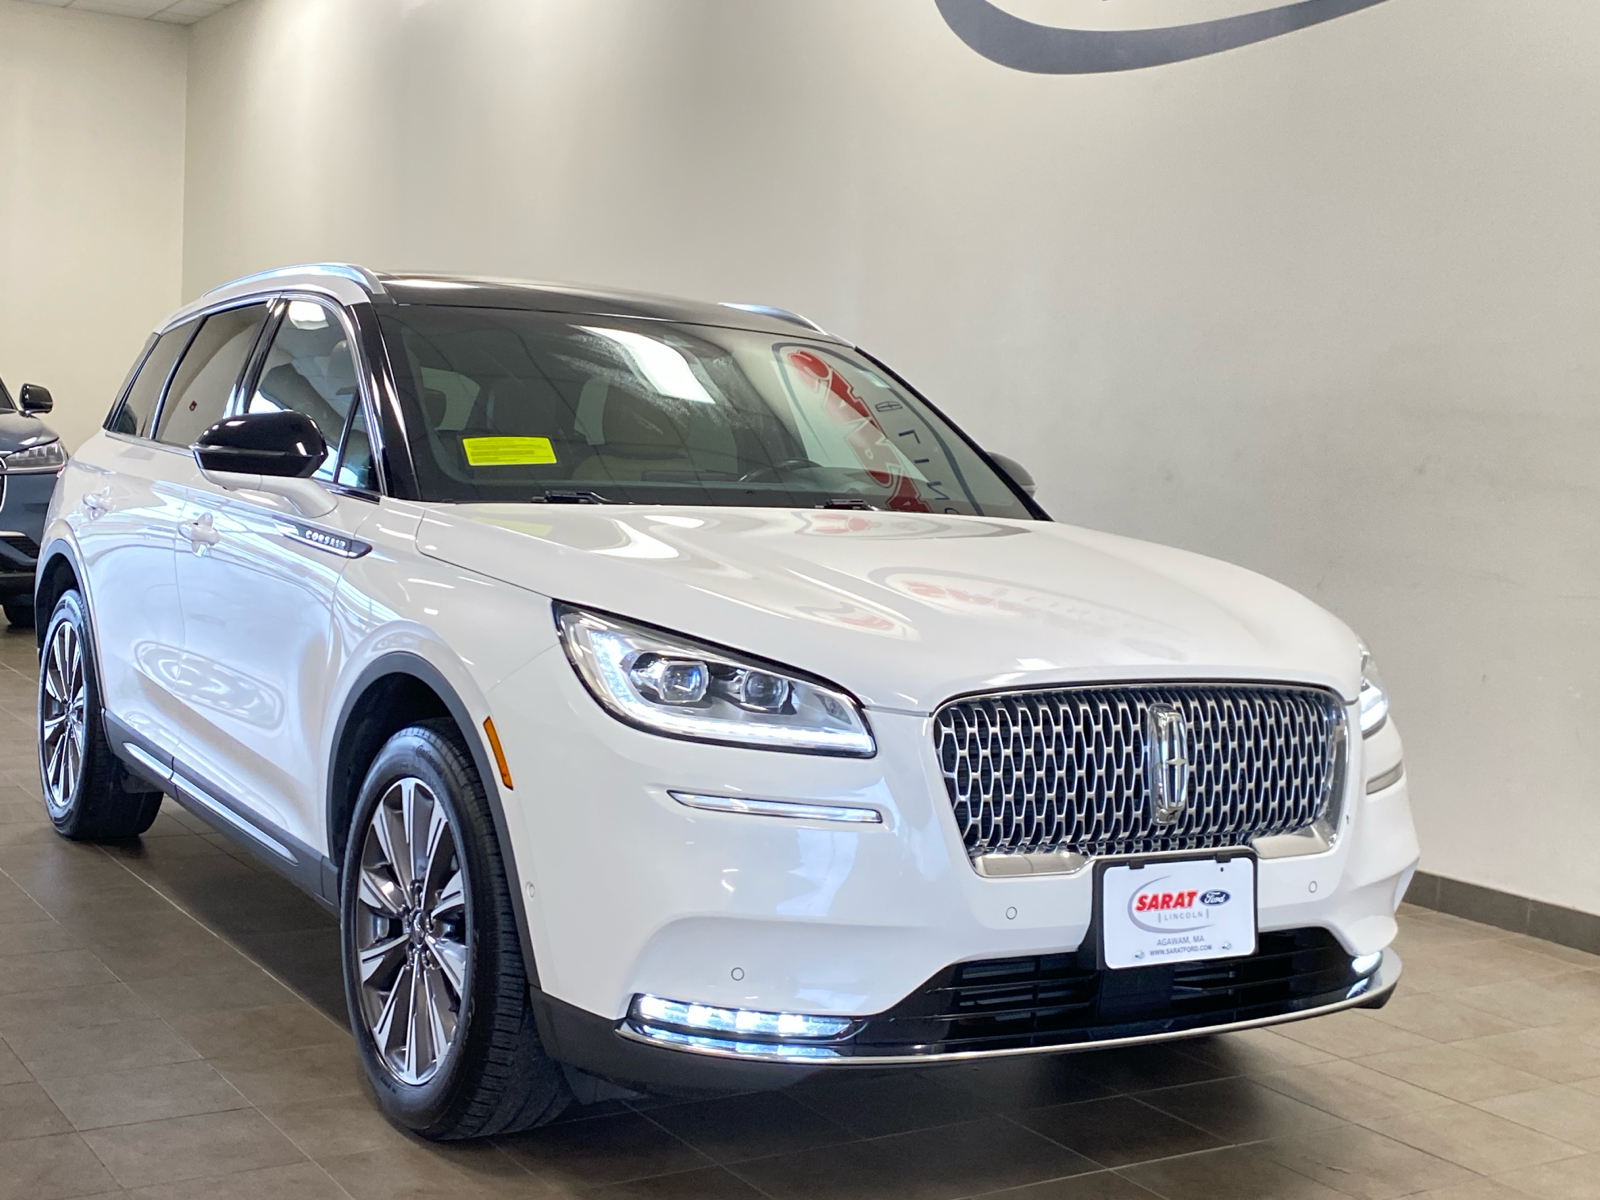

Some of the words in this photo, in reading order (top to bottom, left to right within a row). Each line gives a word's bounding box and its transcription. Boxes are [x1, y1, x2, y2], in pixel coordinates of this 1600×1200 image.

[1135, 890, 1198, 912] SARAT
[1203, 891, 1227, 904] Ford
[1164, 911, 1204, 921] LINCOLN
[1157, 936, 1191, 946] AGAWAM,
[1149, 944, 1212, 955] WWW.SARATFORD.COM
